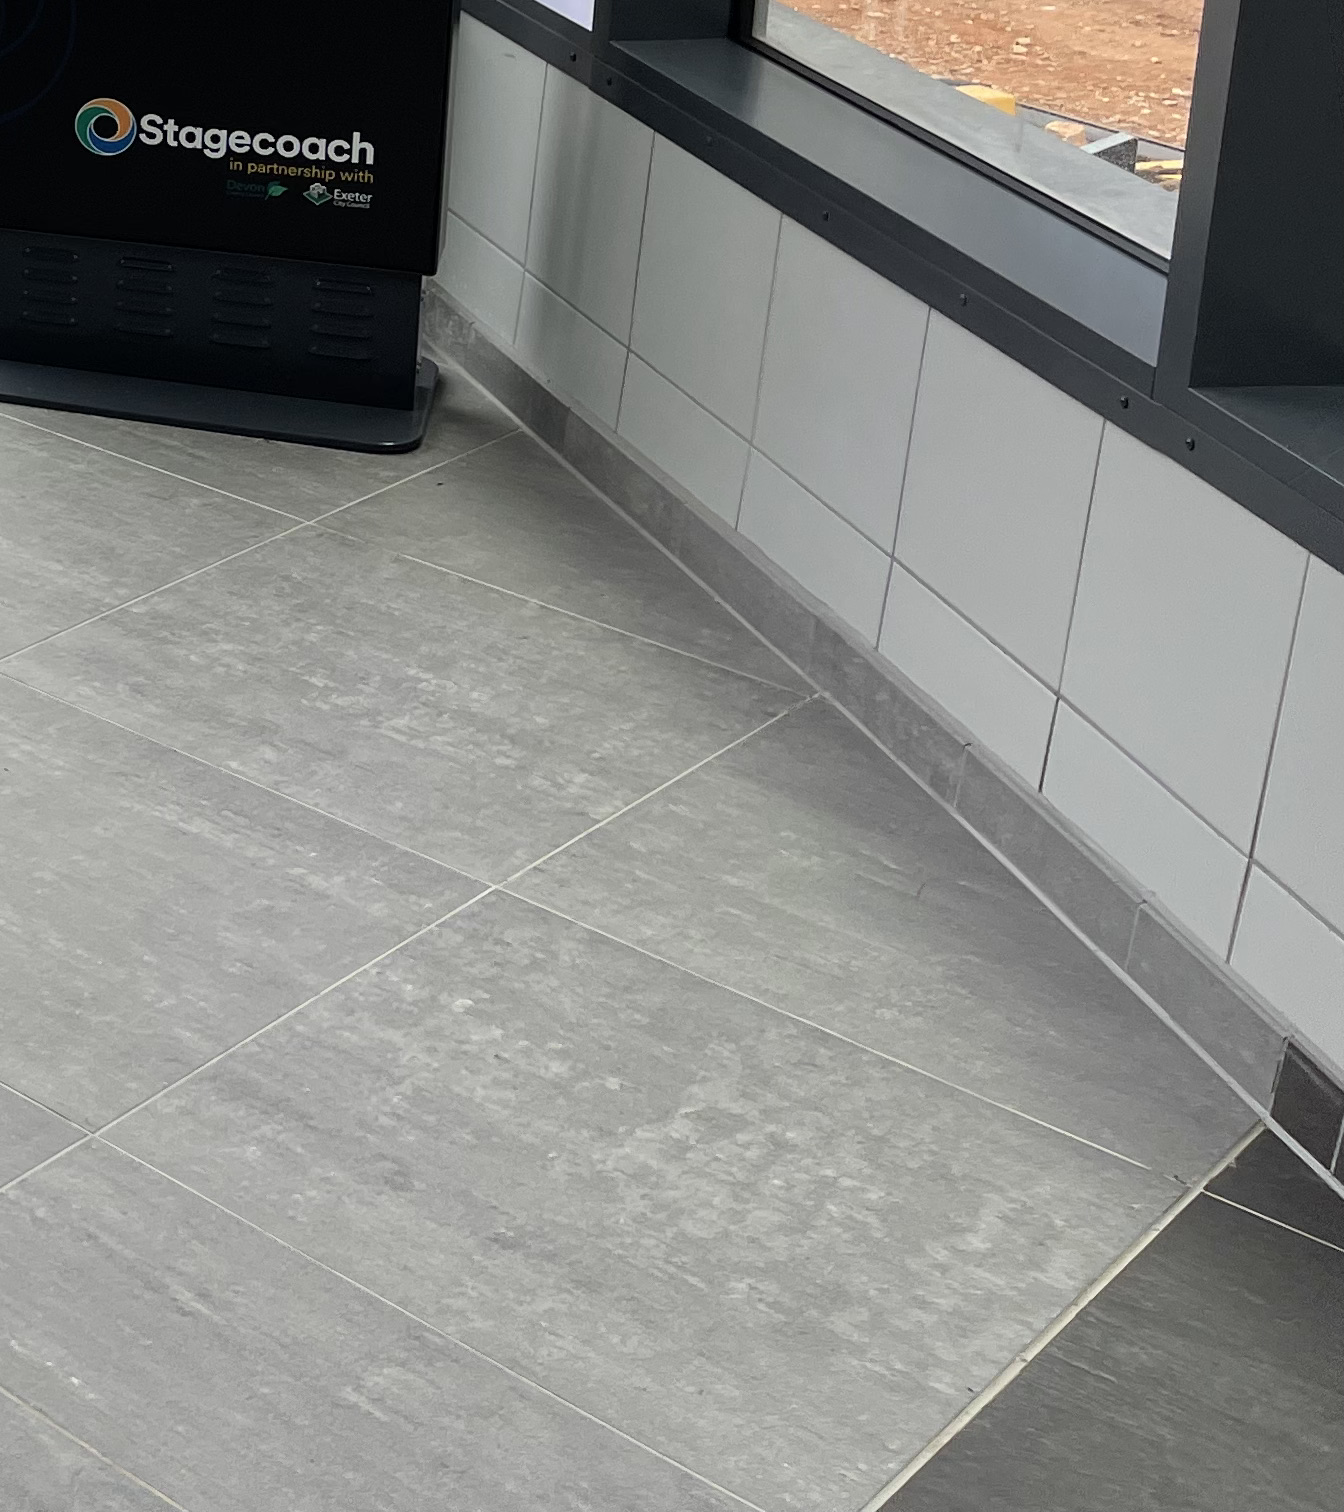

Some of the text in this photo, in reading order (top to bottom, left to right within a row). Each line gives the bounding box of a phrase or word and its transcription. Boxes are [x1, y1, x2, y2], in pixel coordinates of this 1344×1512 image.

[138, 113, 375, 166] Stagecoach
[229, 157, 374, 184] in partnership with
[333, 188, 373, 203] Exeter
